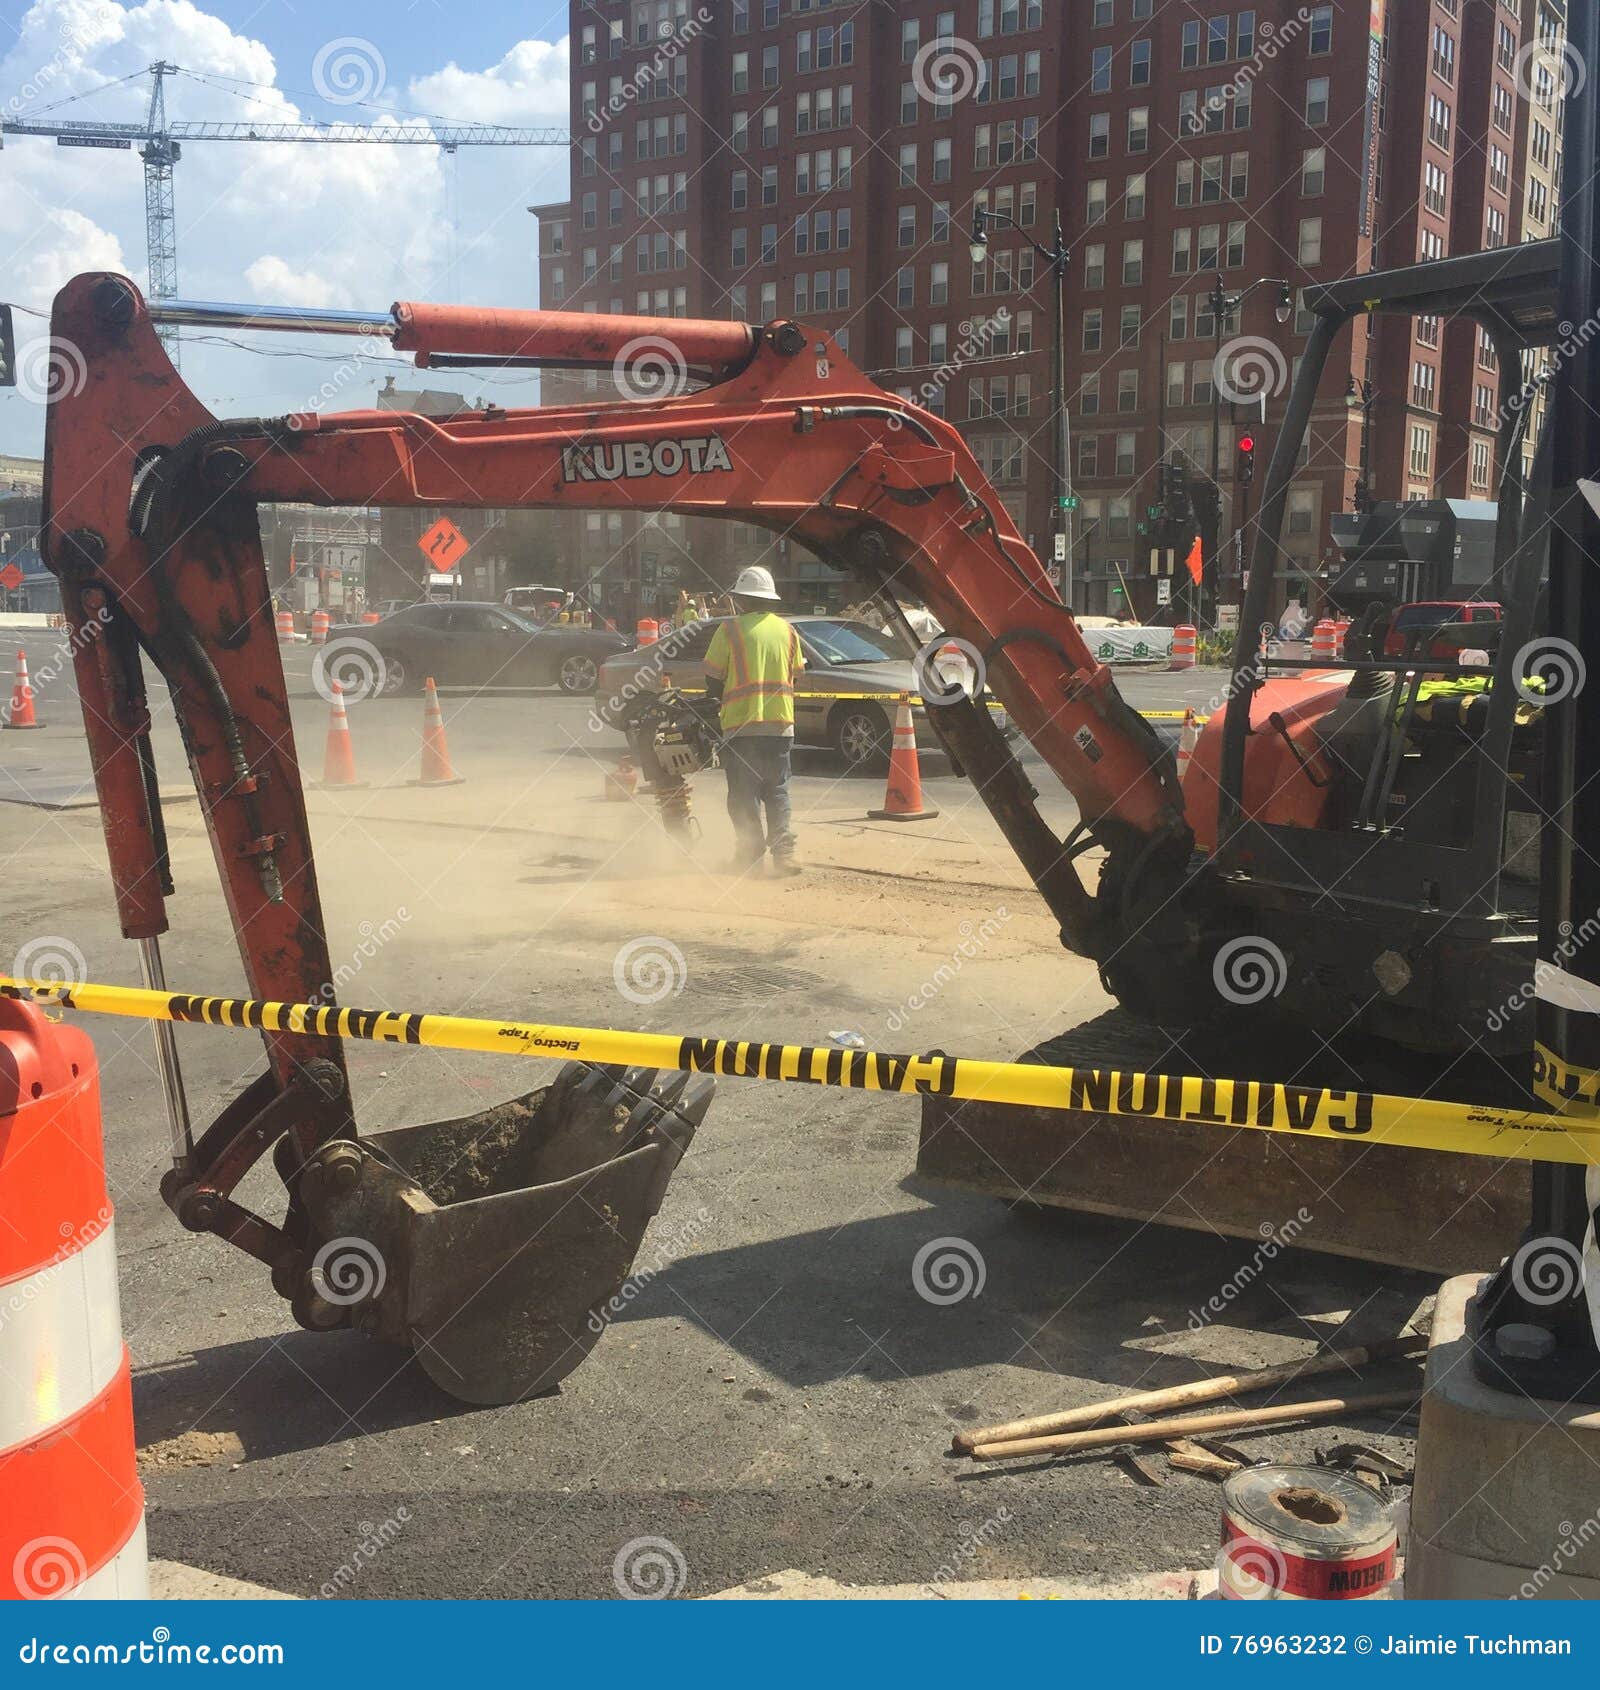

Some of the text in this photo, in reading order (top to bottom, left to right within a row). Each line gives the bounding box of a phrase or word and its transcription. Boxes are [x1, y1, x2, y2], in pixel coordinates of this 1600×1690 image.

[563, 437, 734, 482] KUBOTA
[498, 1027, 580, 1051] Electro Tape
[679, 1037, 957, 1096] CAUTION
[1070, 1068, 1373, 1135] CAUTION
[1328, 1561, 1386, 1592] BELOW
